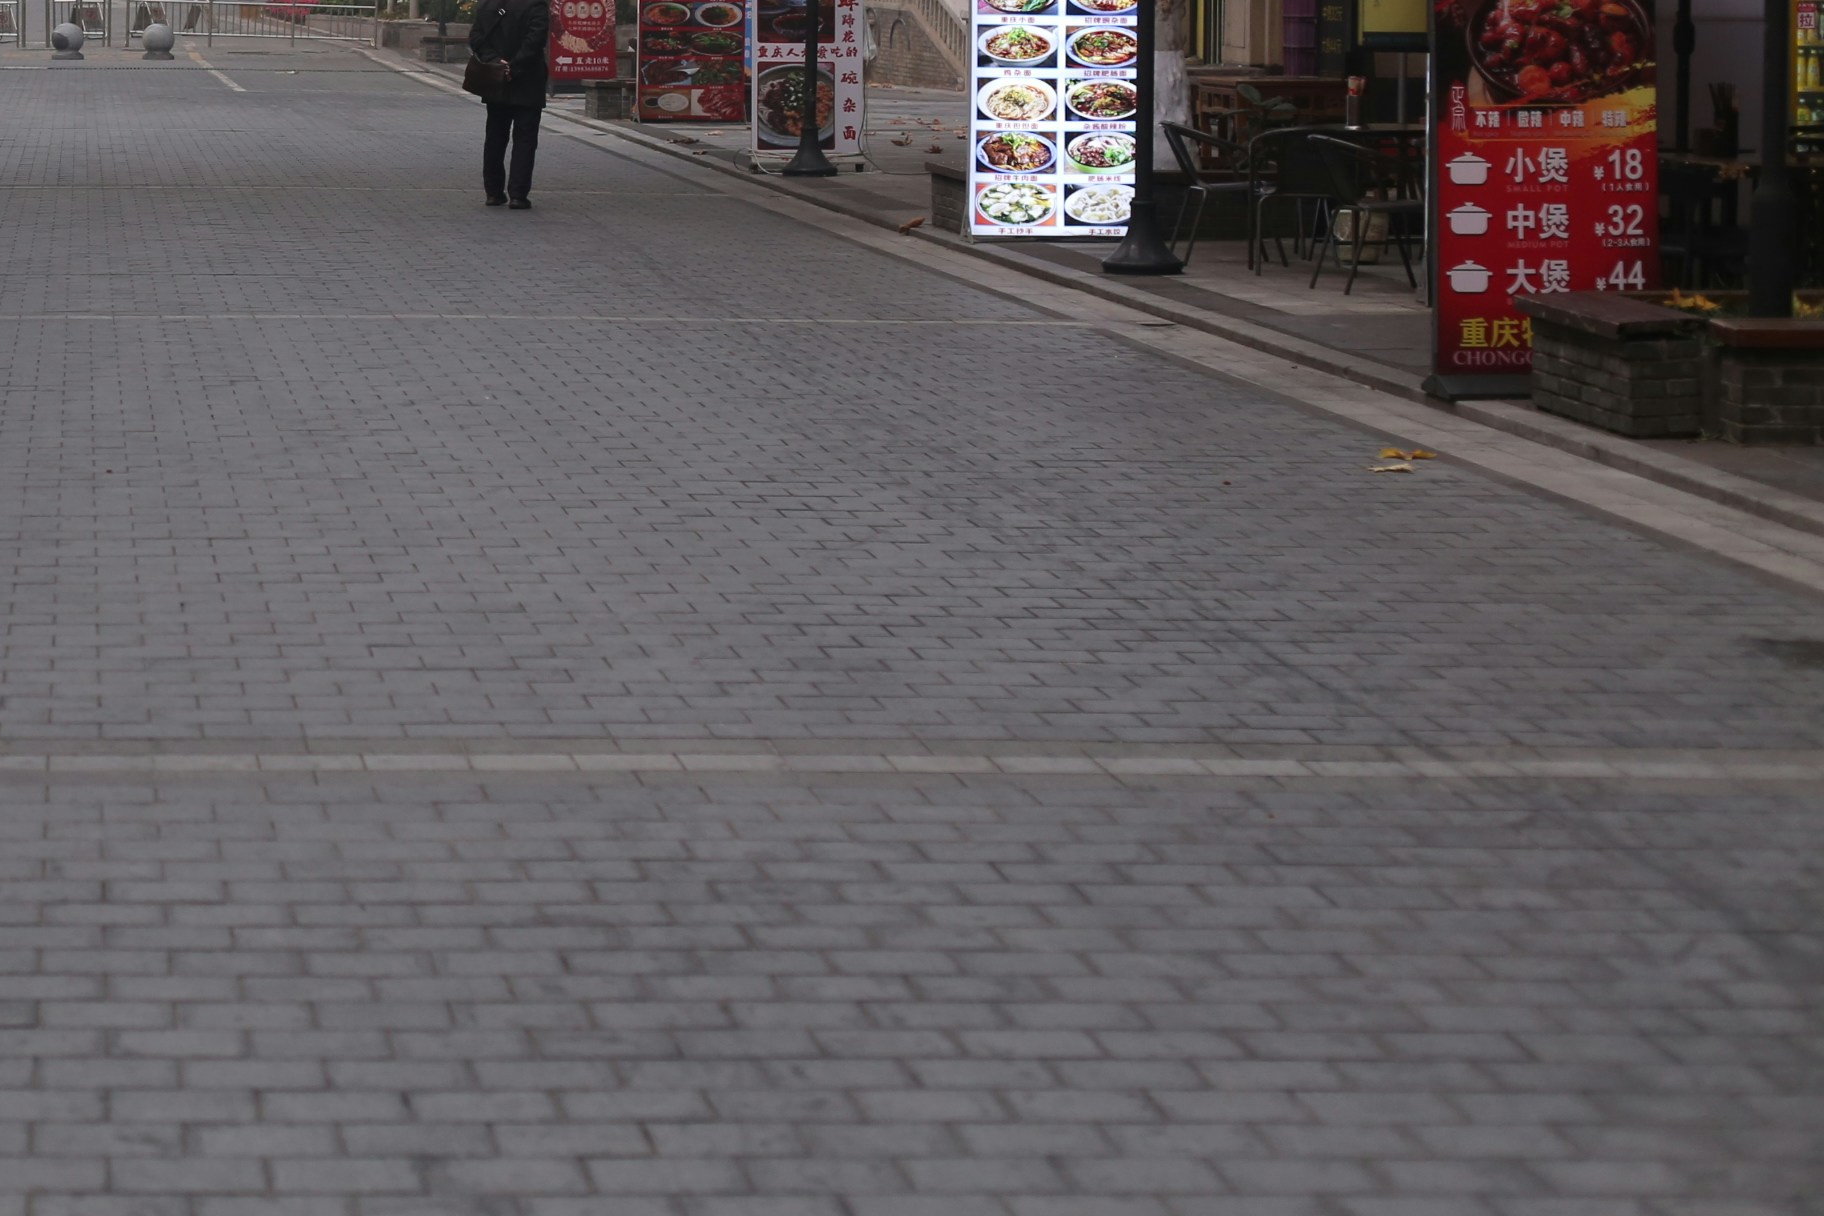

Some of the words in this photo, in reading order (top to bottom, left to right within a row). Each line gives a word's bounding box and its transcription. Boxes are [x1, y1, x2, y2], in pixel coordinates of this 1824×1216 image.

[1475, 111, 1501, 128] 不辣
[1517, 111, 1543, 128] 微辣
[1559, 111, 1585, 128] 中辣
[1602, 111, 1627, 128] 特辣
[1505, 147, 1569, 183] 小煲
[1506, 203, 1570, 240] 中煲
[1550, 240, 1570, 248] POT
[1506, 258, 1571, 294] 大煲
